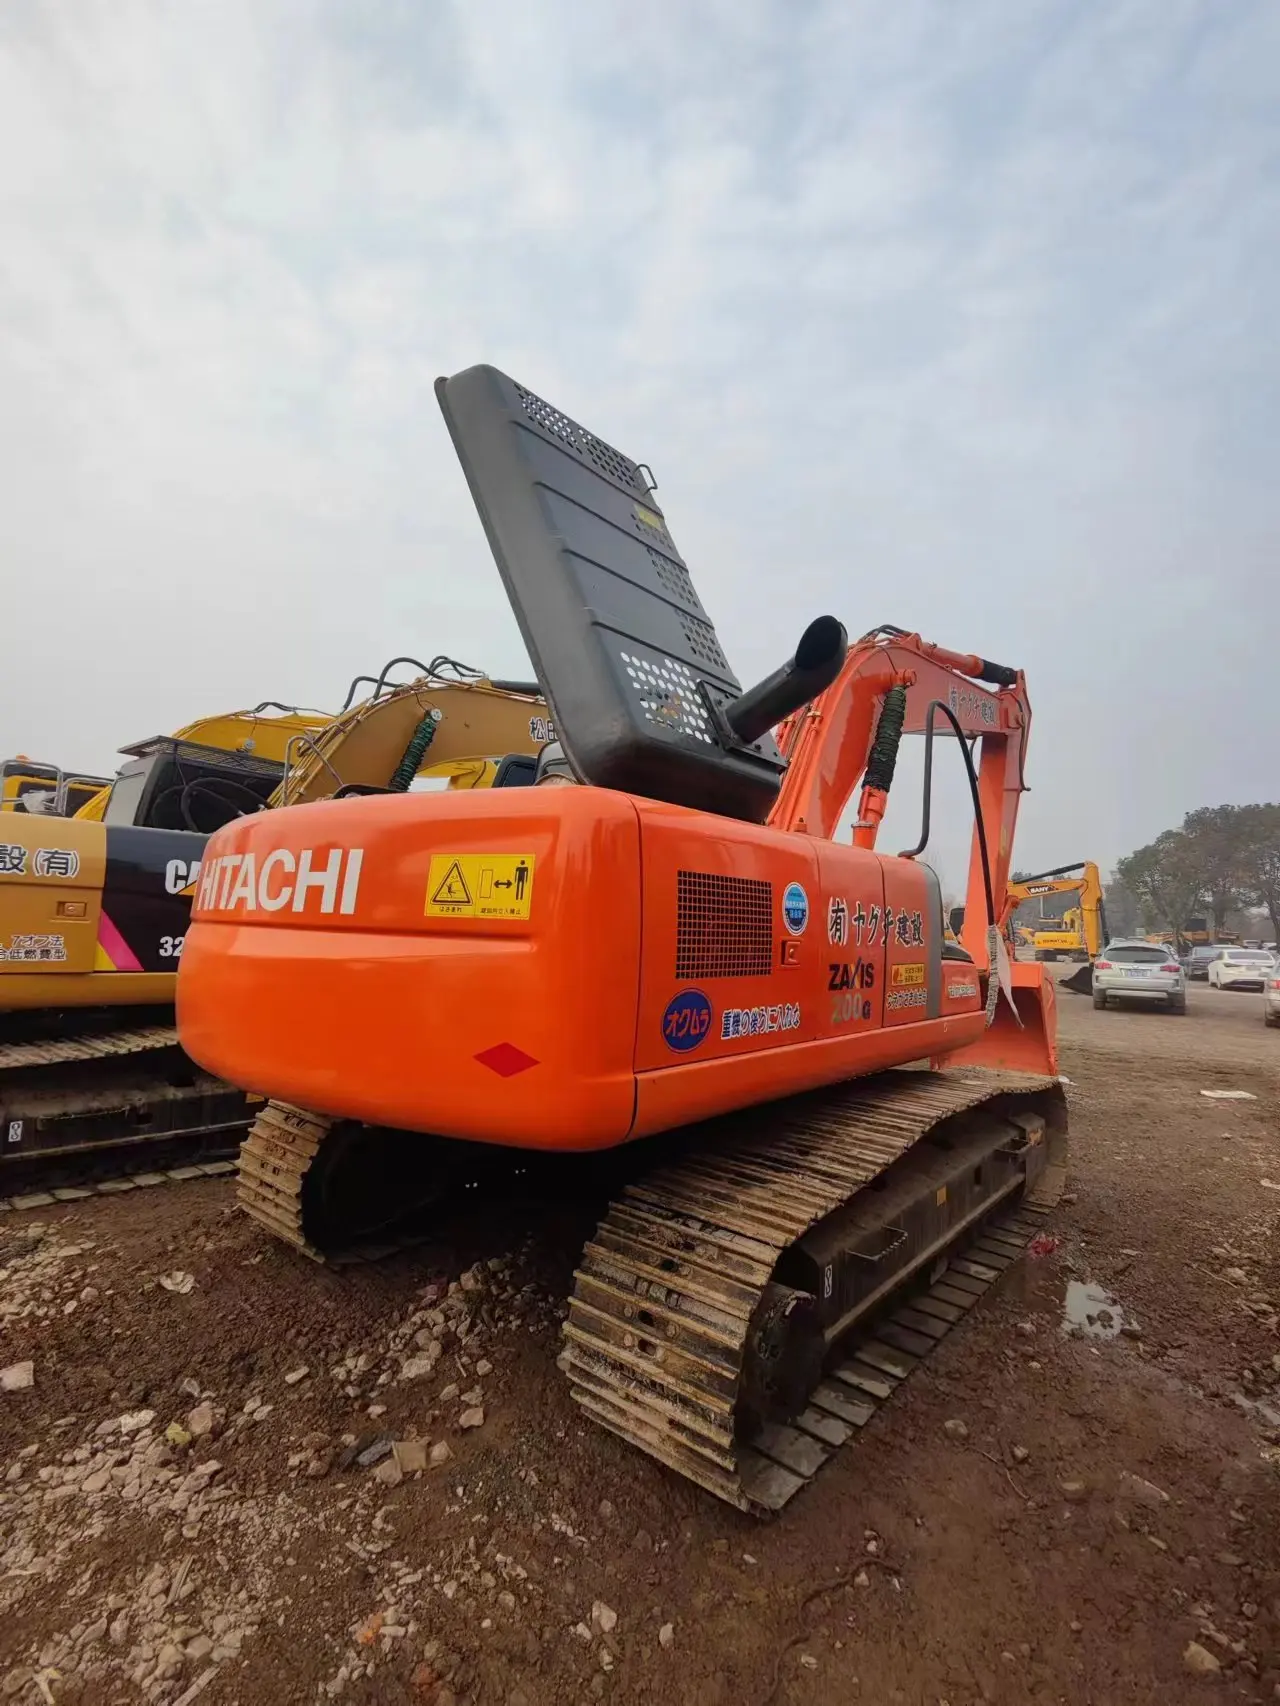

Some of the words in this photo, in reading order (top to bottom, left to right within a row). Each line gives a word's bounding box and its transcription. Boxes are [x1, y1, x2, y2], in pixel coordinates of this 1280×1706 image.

[197, 848, 364, 915] HITACHI
[1030, 886, 1049, 894] SANY
[828, 956, 875, 991] ZAXIS
[665, 1008, 709, 1037] オクムラ
